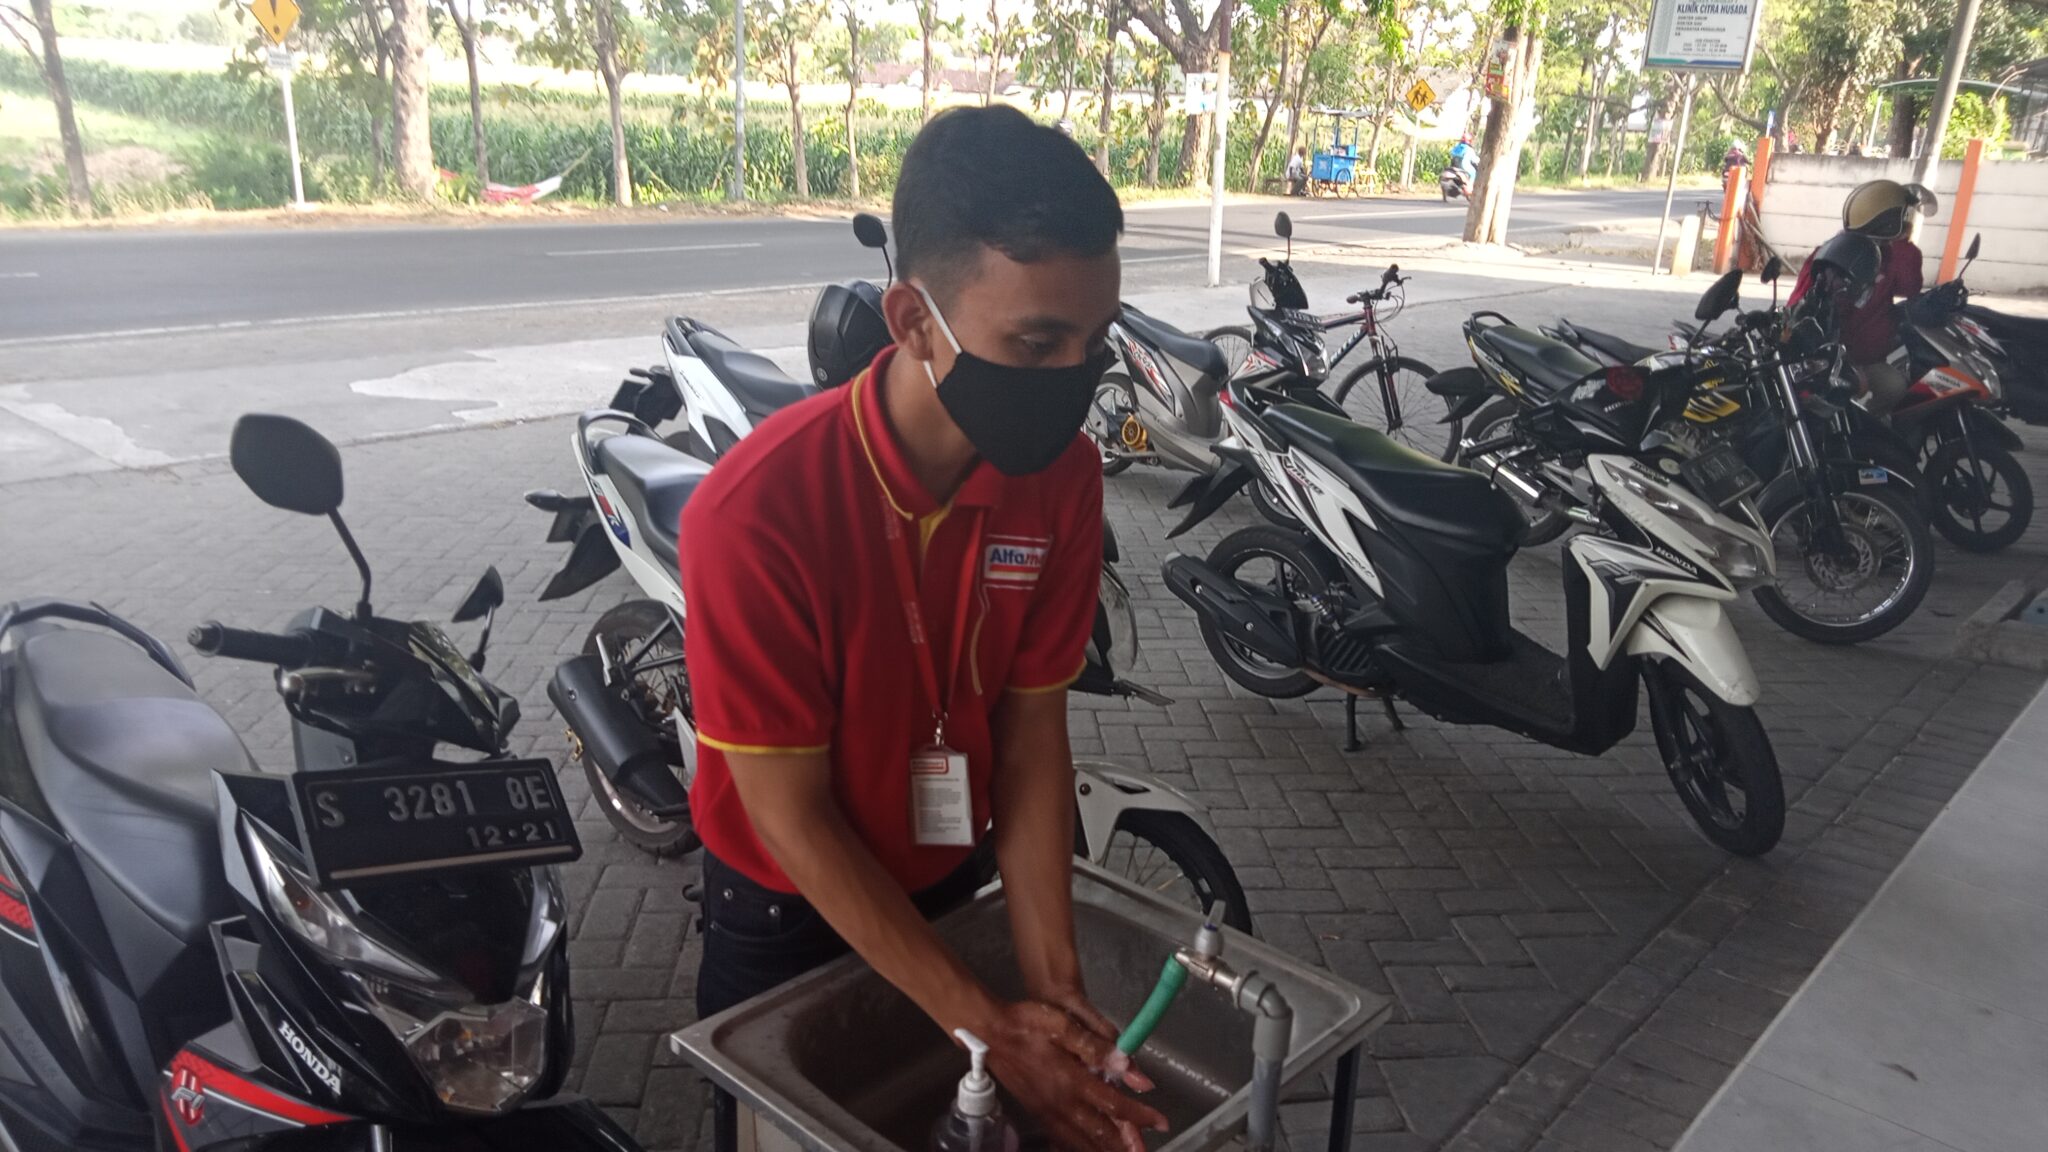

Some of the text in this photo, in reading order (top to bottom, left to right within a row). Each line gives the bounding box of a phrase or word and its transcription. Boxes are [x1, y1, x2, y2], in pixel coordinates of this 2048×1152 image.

[1677, 3, 1748, 15] KLINIK CITRA HUSADA
[1655, 546, 1699, 575] HONDA
[316, 790, 346, 828] S
[383, 779, 477, 823] 3281
[278, 1019, 342, 1096] HONDA
